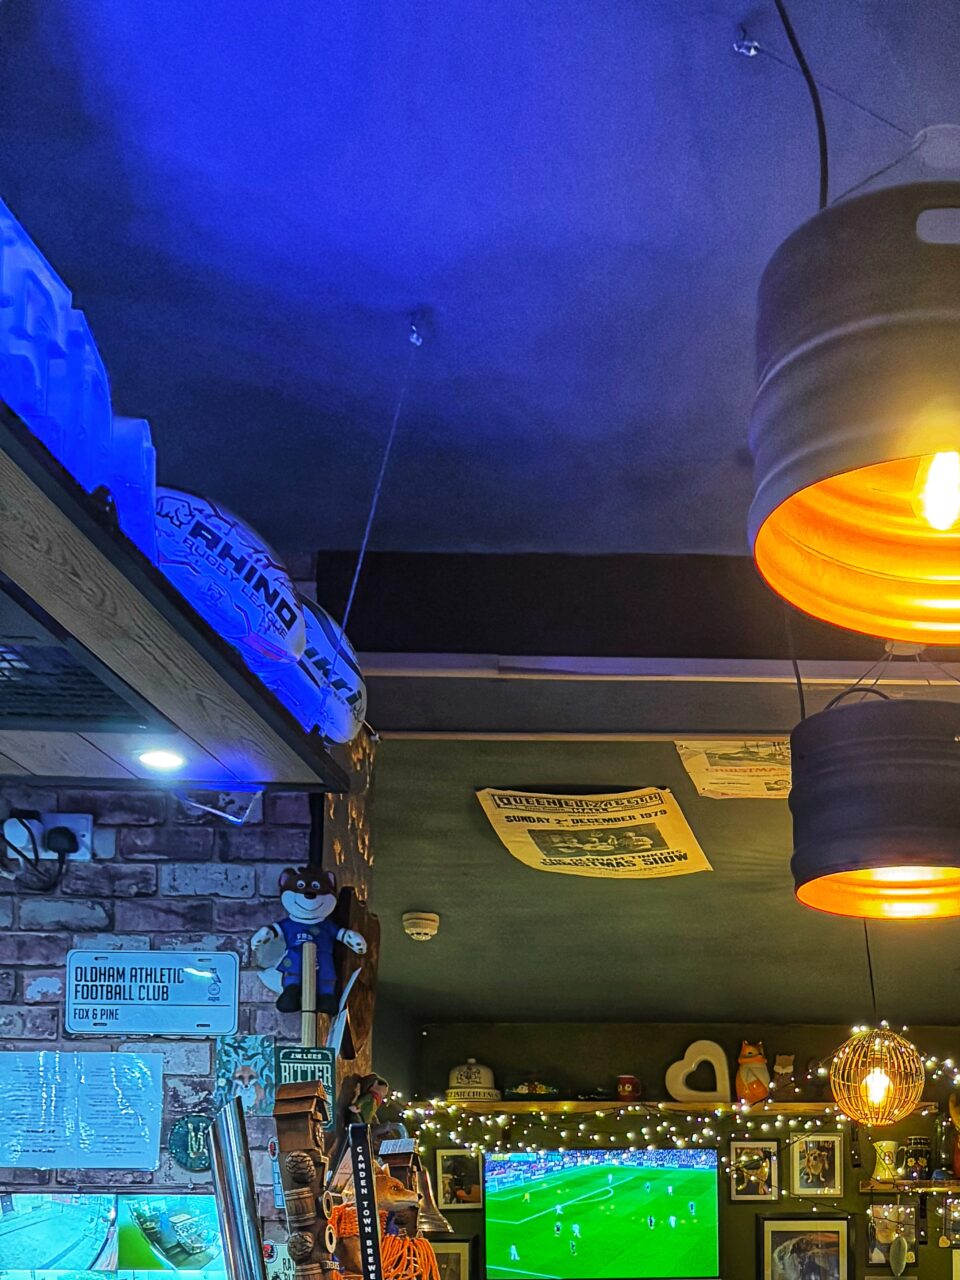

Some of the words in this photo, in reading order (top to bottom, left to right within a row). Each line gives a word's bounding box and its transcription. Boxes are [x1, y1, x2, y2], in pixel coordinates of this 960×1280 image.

[183, 537, 240, 583] RUGBY
[242, 586, 289, 639] LEAGUE
[504, 815, 550, 824] SUNDAY
[571, 815, 636, 825] DECEMBER
[639, 809, 667, 819] 1979
[641, 853, 688, 866] SHOW
[74, 966, 126, 983] OLDHAM
[130, 967, 185, 984] ATHLETIC
[74, 984, 135, 1001] FOOTBALL
[138, 985, 169, 1001] CLUB
[73, 1008, 90, 1020] FOX
[92, 1008, 98, 1020] &
[100, 1009, 120, 1020] PINE
[280, 1063, 333, 1088] BITTER
[356, 1146, 368, 1194] CAMDEN
[362, 1201, 372, 1233] TOWN
